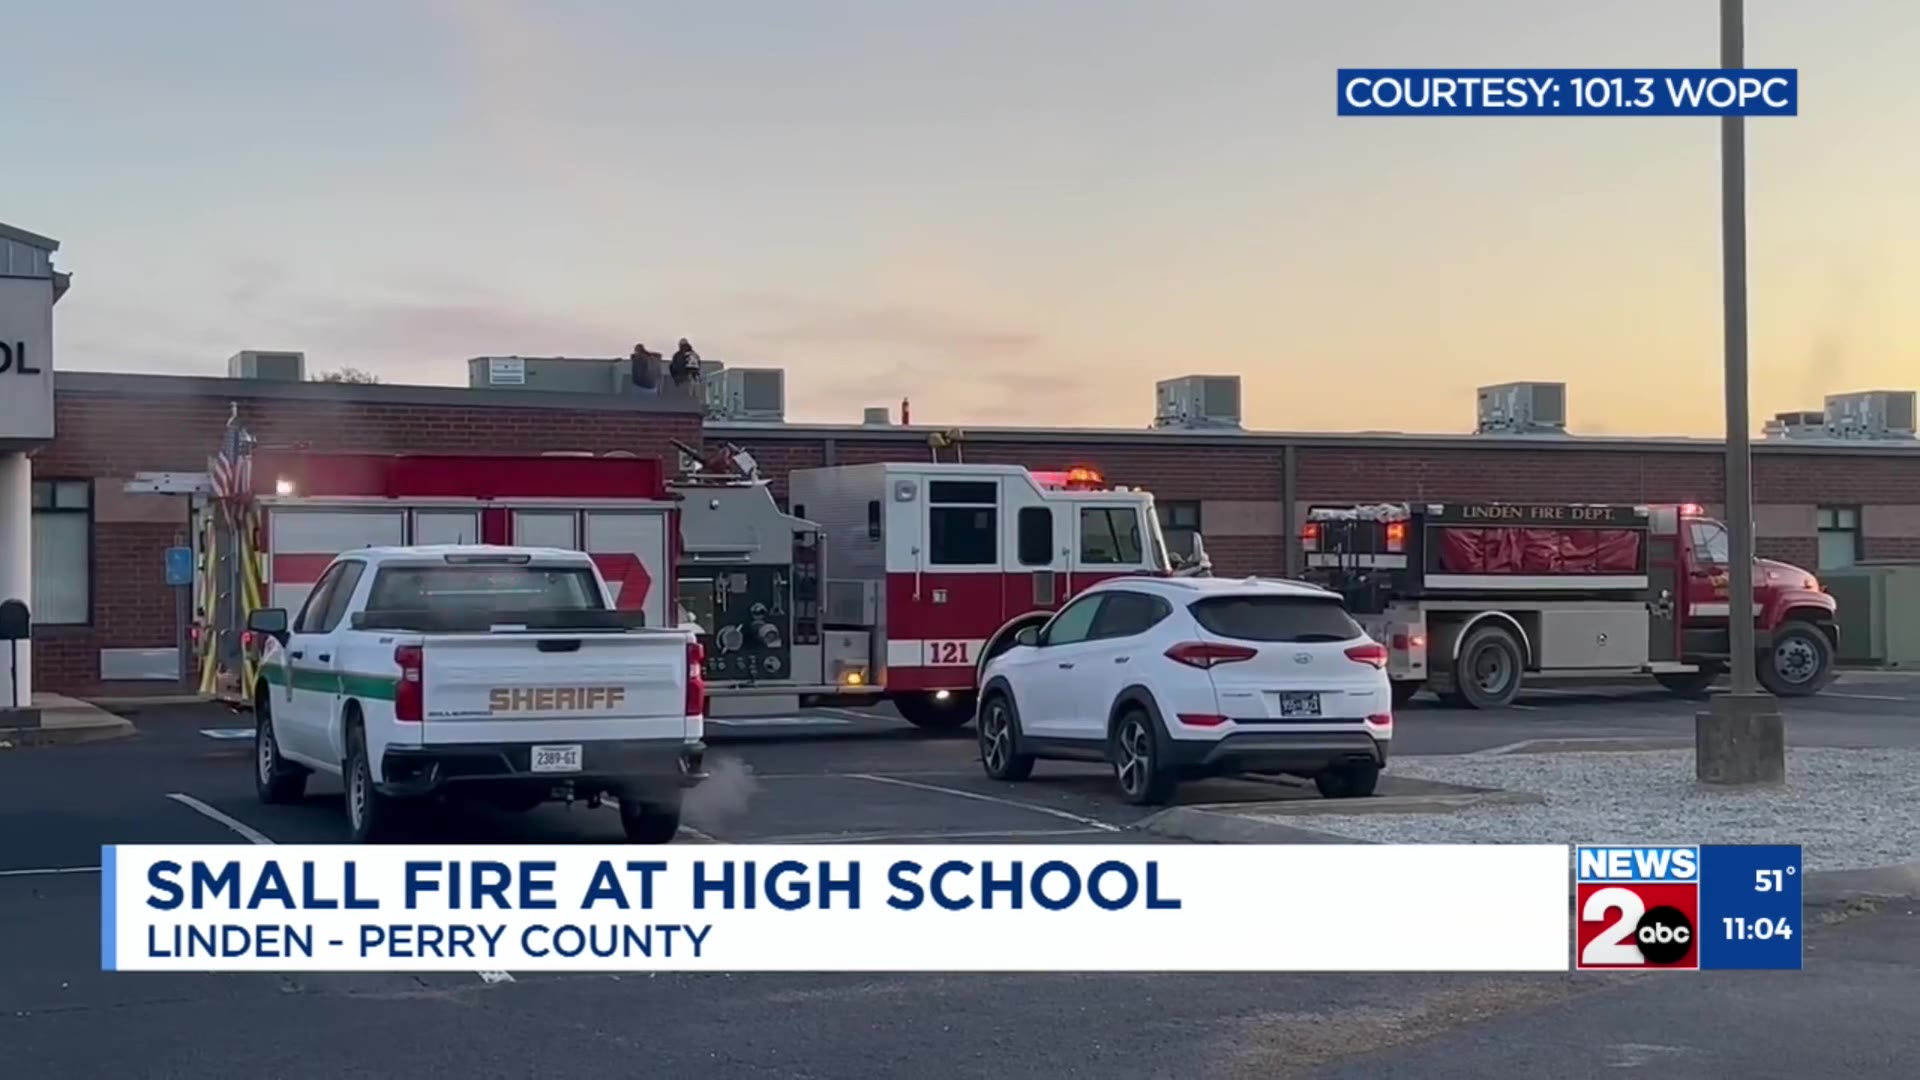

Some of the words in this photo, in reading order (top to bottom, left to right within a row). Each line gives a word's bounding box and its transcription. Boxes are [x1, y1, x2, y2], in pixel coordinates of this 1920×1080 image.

[1463, 506, 1523, 519] LINDEN
[1531, 507, 1565, 519] FIRE
[1572, 508, 1615, 520] DEPT.
[930, 642, 969, 663] 121
[489, 687, 625, 711] SHERIFF
